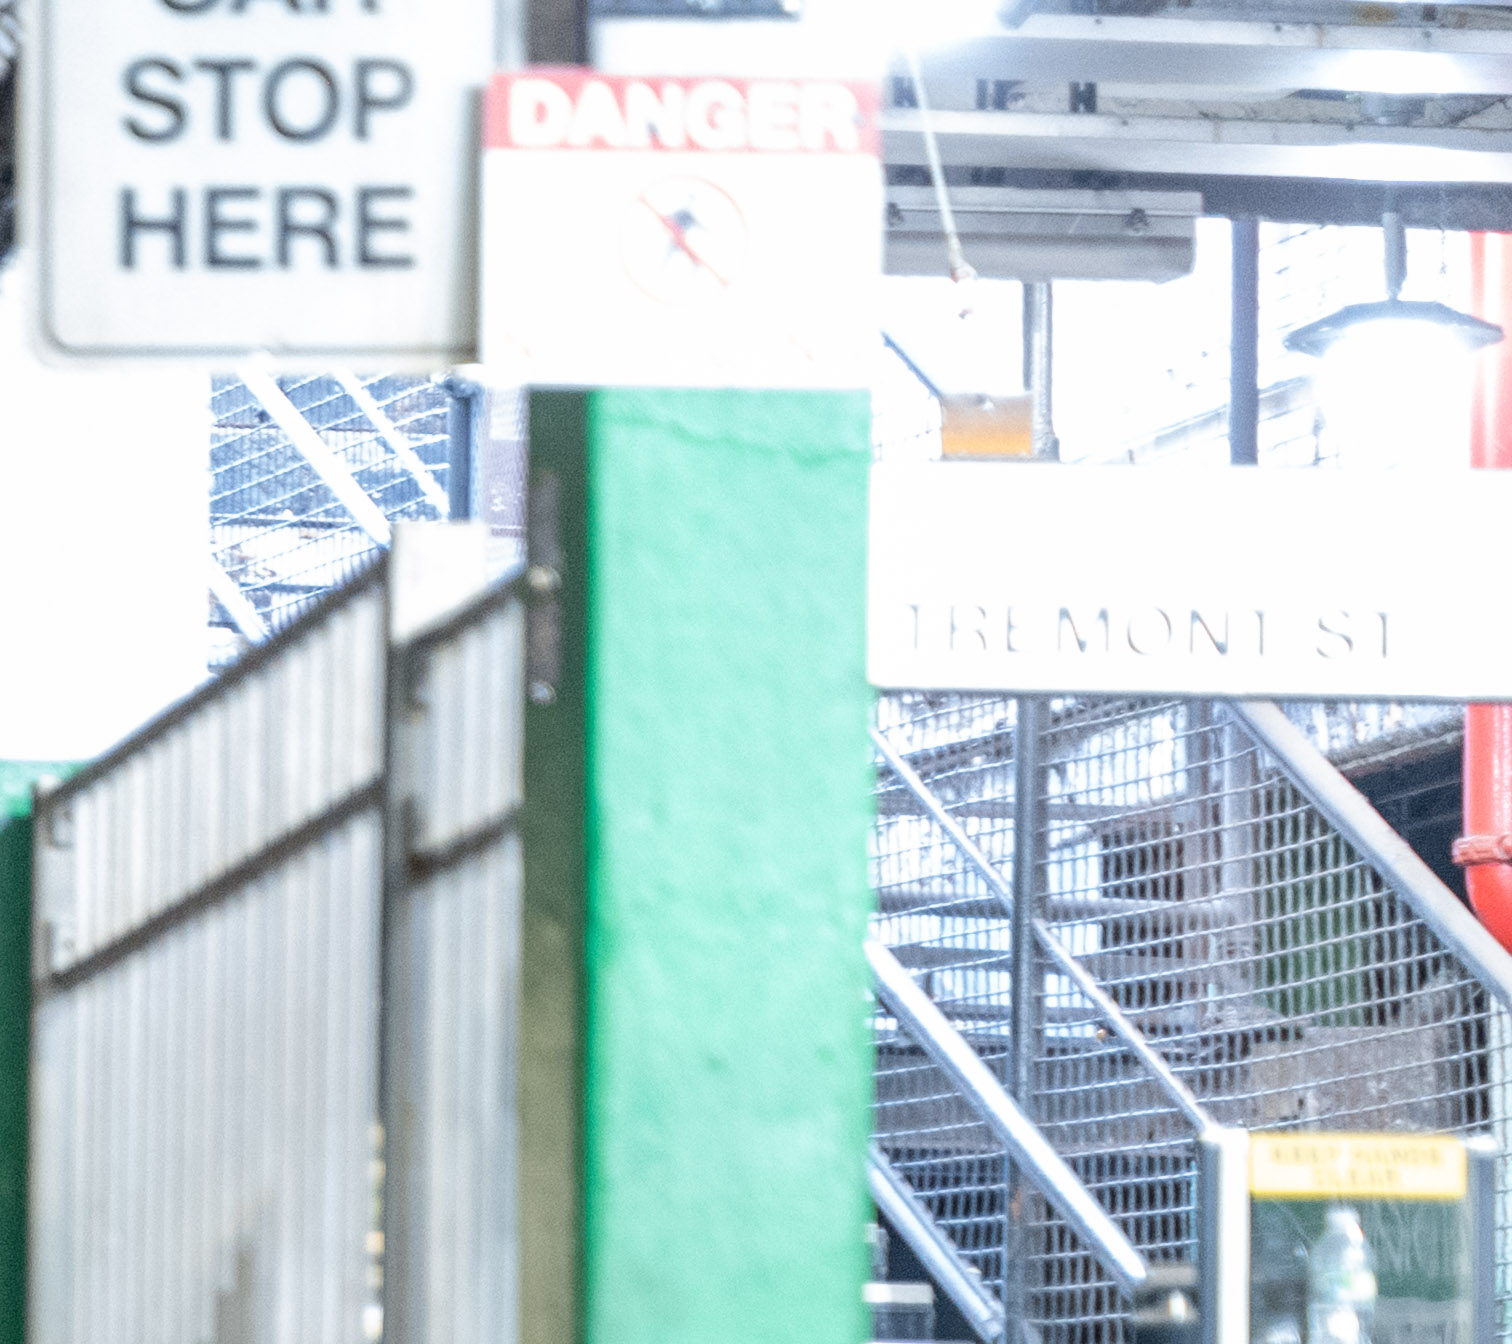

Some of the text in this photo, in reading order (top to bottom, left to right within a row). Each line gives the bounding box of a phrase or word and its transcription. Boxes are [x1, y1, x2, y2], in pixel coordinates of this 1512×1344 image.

[120, 55, 416, 146] STOP
[509, 76, 861, 150] DANGER
[118, 182, 416, 273] HERE
[904, 602, 1396, 659] TREMONT ST
